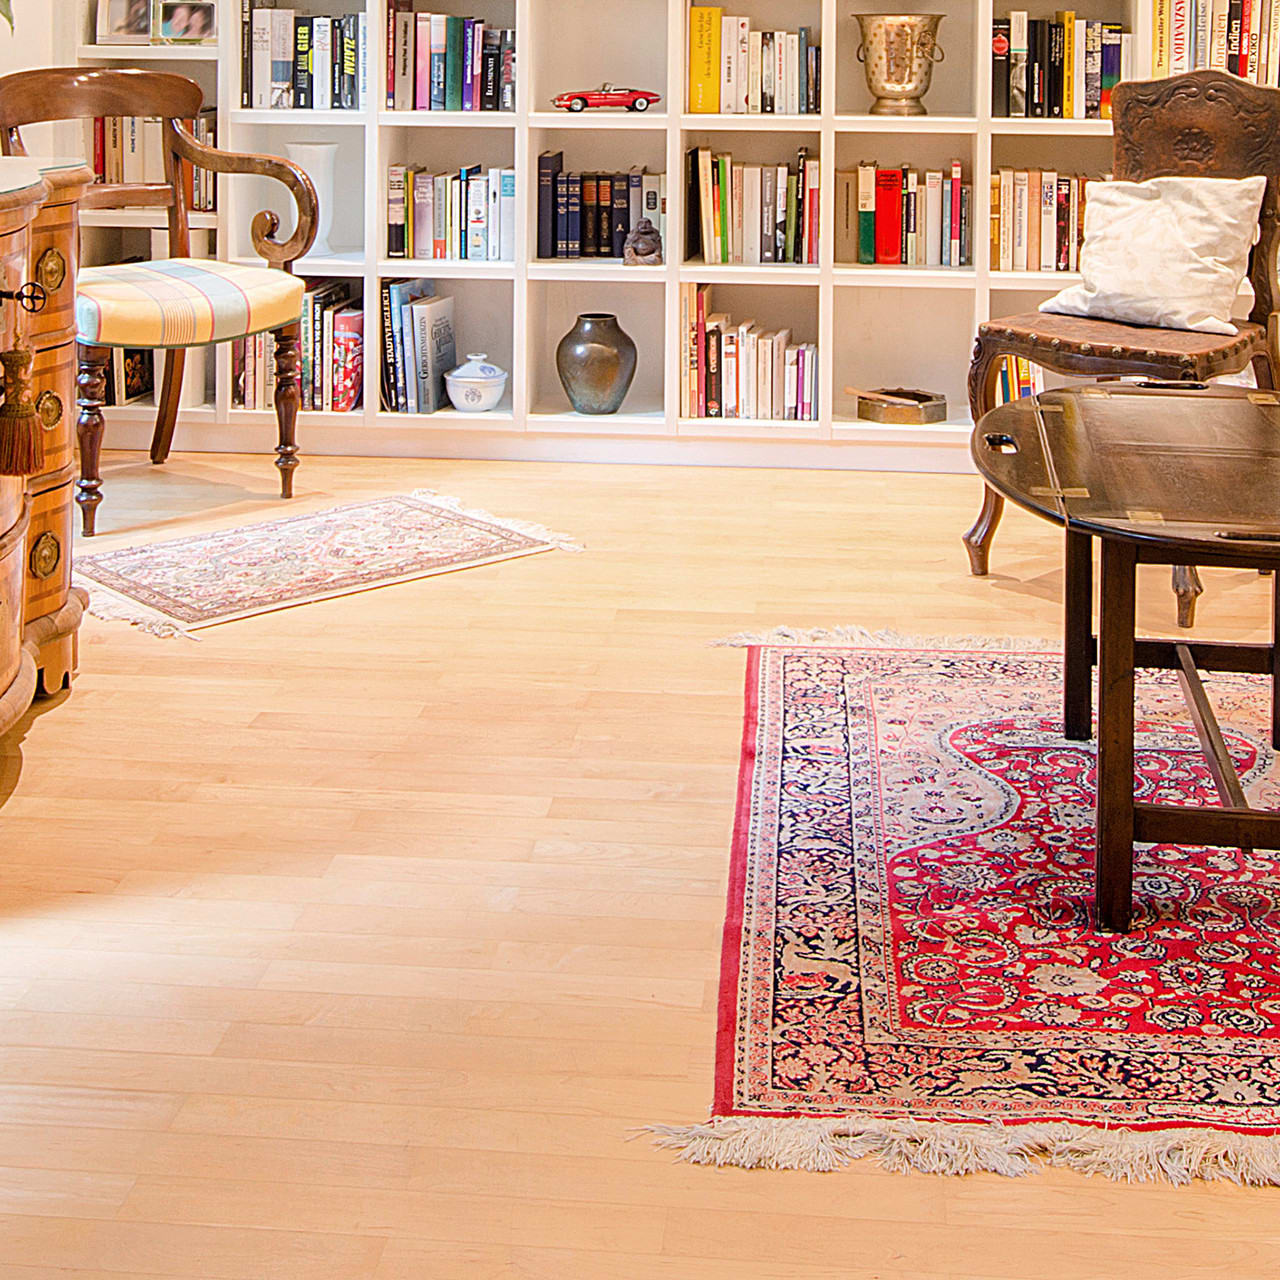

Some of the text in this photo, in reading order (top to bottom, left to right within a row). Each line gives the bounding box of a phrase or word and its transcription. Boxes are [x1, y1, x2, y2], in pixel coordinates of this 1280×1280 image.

[1156, 0, 1165, 17] Welt
[1156, 17, 1165, 35] aller
[1271, 0, 1280, 33] AMERIKA
[297, 26, 309, 52] GIER
[1228, 19, 1240, 56] Indien
[1249, 32, 1258, 74] MEXIKO
[344, 37, 356, 76] ZLATAN
[1156, 50, 1164, 68] Tiere
[486, 57, 494, 96] ILLUMINATI
[381, 288, 395, 364] STADTVERGLEICH
[418, 316, 430, 381] GERICHTSMEDIZIN
